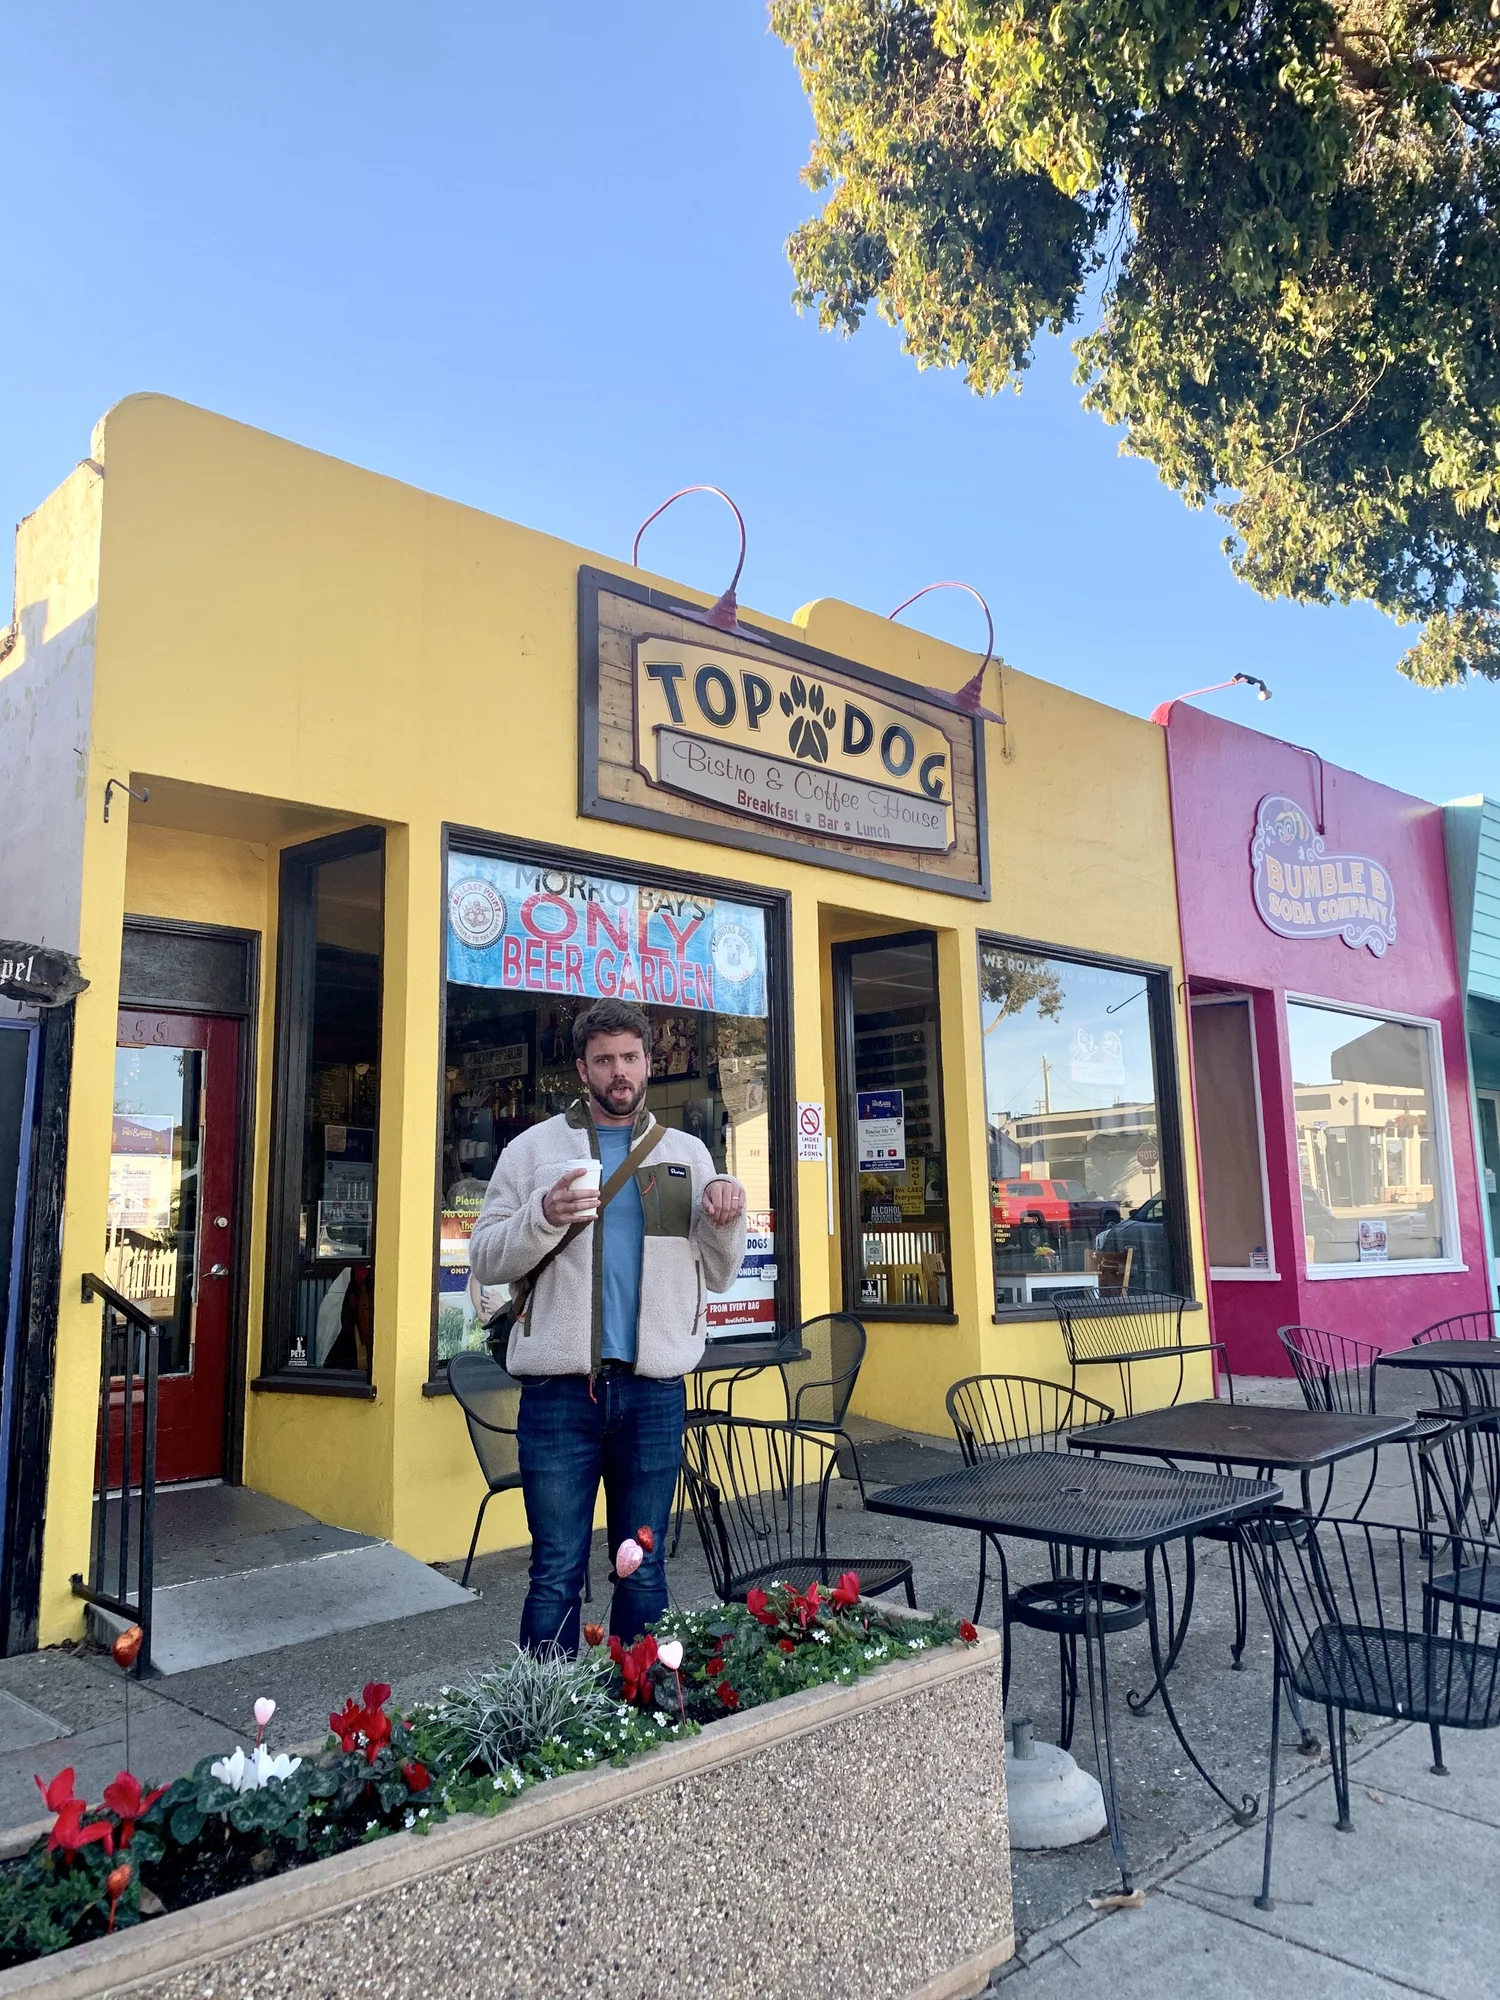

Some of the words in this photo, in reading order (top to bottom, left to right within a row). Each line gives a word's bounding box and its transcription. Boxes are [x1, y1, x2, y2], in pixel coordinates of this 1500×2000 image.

[643, 661, 774, 732] TOP
[841, 700, 947, 799] DOG
[672, 740, 755, 784] Bistro
[766, 767, 784, 791] &
[794, 771, 859, 813] Coffee
[867, 790, 939, 830] House
[737, 788, 799, 823] Breakfast
[818, 813, 838, 832] Bar
[856, 820, 891, 839] Lunch
[1265, 853, 1366, 899] BUMBLE
[1369, 866, 1387, 902] B
[515, 864, 630, 906] MORRO
[638, 885, 706, 922] BAY'S
[1269, 892, 1316, 925] SODA
[1318, 896, 1389, 926] COMPANY
[520, 892, 703, 961] ONLY
[503, 935, 585, 994] BEER
[594, 948, 716, 1011] GARDEN
[982, 953, 1003, 970] WE
[455, 1195, 484, 1206] Please
[457, 1208, 482, 1218] Outsid
[871, 1205, 902, 1215] ALCOHOL
[747, 1239, 768, 1249] DOGS
[450, 1267, 469, 1275] ONLY
[710, 1303, 728, 1313] FROM
[729, 1302, 747, 1312] EVERY
[748, 1301, 760, 1310] BAG
[290, 1349, 306, 1358] PETS
